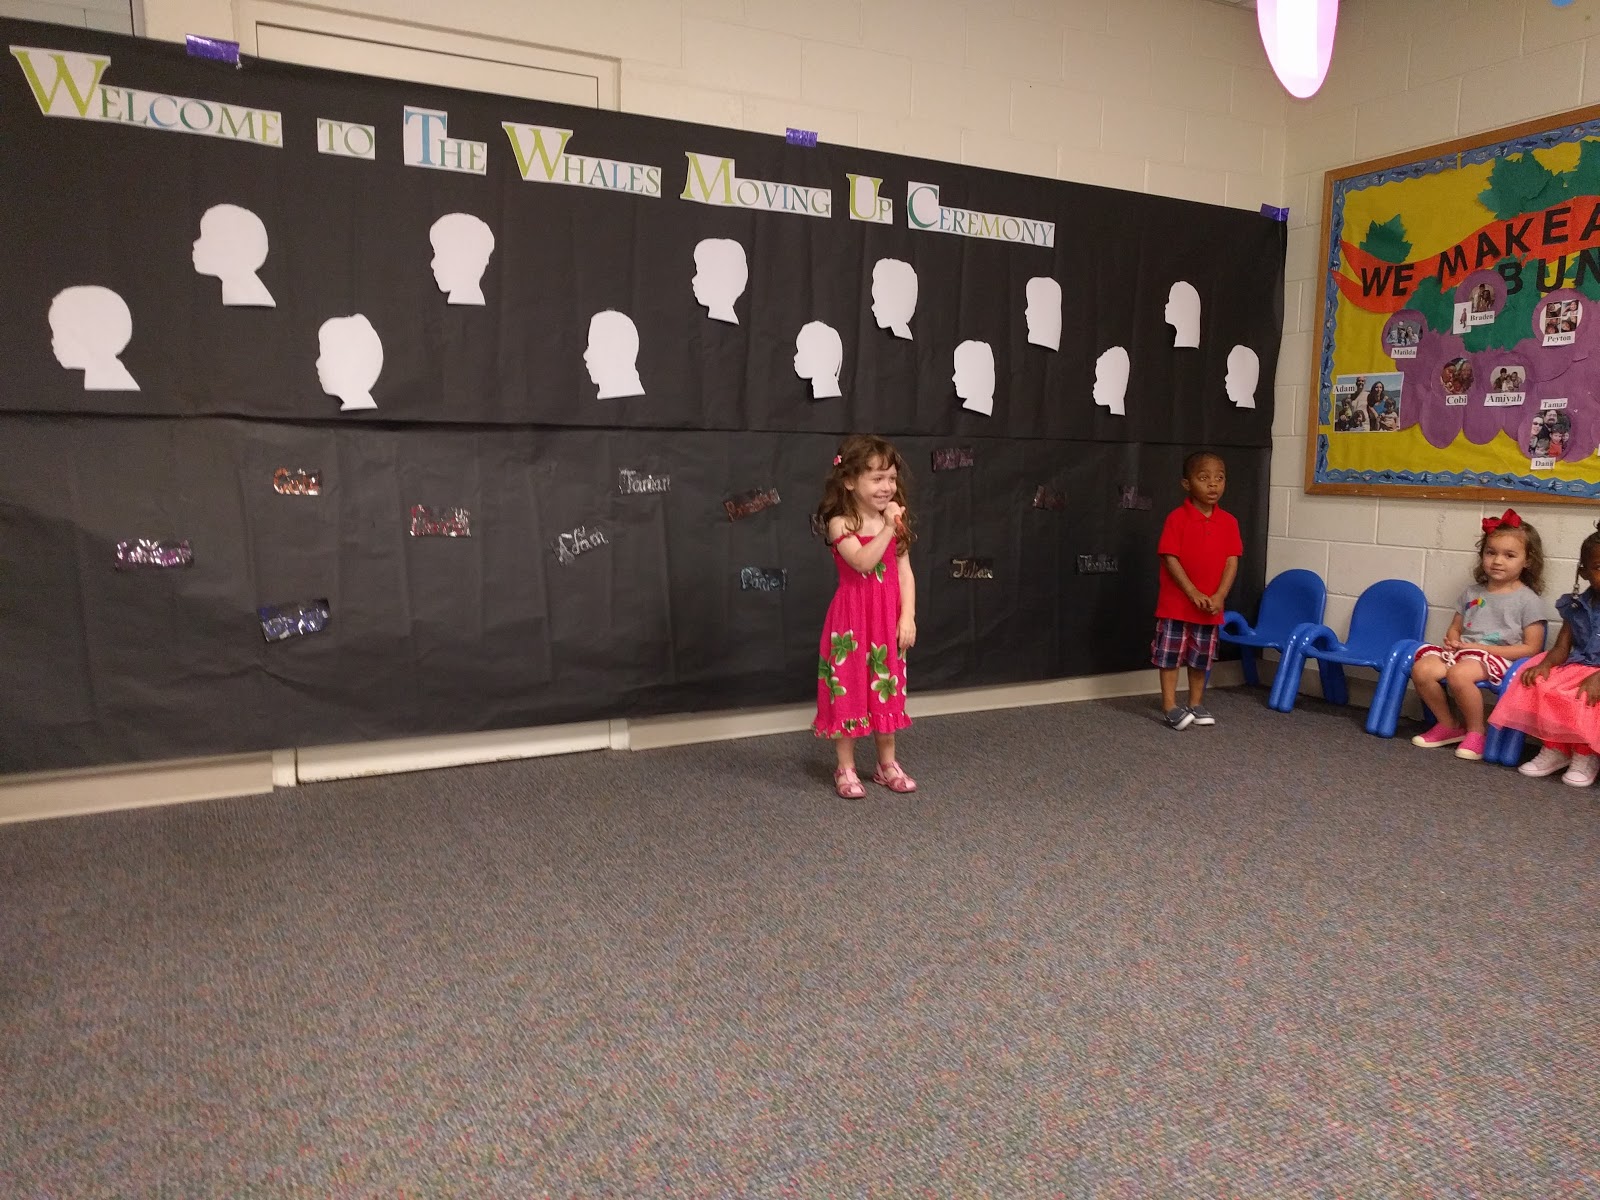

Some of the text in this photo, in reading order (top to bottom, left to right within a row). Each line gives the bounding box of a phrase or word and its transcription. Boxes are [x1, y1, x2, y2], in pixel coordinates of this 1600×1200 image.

[318, 119, 374, 156] TO
[1361, 264, 1414, 297] WE
[1437, 206, 1572, 283] MAKE
[1469, 312, 1494, 323] Braden
[1547, 333, 1572, 343] Peyton
[1333, 384, 1355, 394] Adam
[1446, 395, 1467, 405] Cobi
[1487, 393, 1523, 405] Amiyah
[1543, 401, 1567, 409] Tamar
